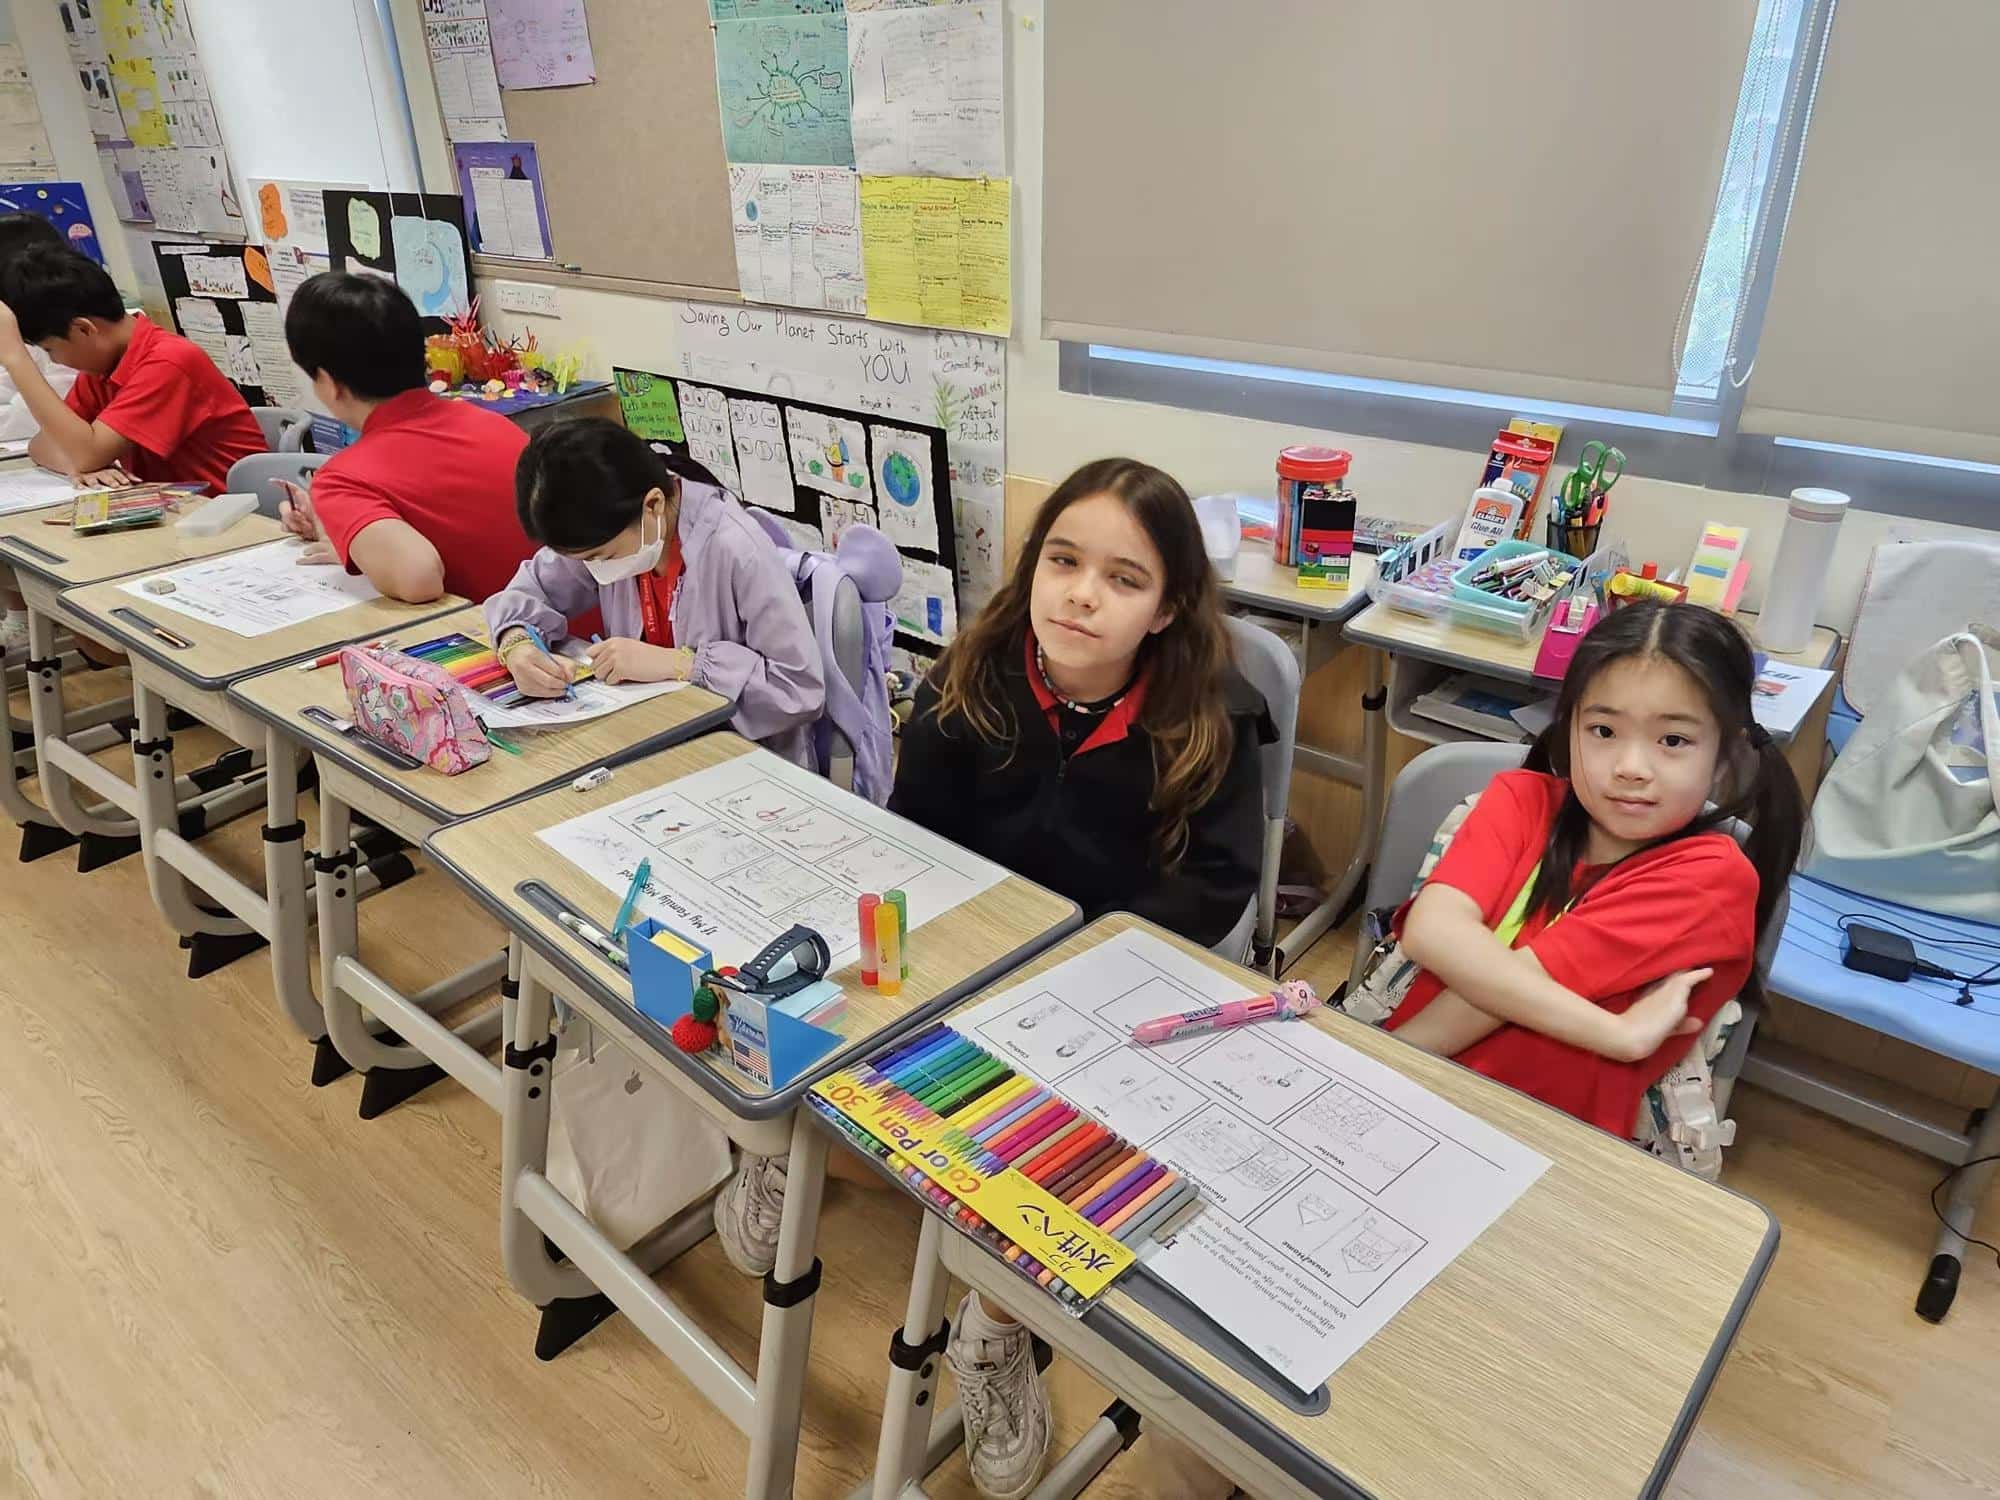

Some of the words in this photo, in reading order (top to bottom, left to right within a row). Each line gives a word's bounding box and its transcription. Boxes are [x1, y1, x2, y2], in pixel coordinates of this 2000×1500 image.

[680, 306, 730, 336] Saving
[737, 311, 762, 332] Our
[775, 310, 815, 341] Planet
[827, 324, 868, 348] Starts
[860, 354, 911, 384] YOU
[959, 422, 999, 443] Products
[658, 895, 690, 918] Family
[689, 915, 706, 932] My
[701, 924, 718, 935] If
[830, 1084, 868, 1111] 30
[1093, 1105, 1109, 1118] Food
[879, 1117, 923, 1150] Pen
[1314, 1146, 1344, 1167] Weather
[918, 1149, 981, 1193] Color
[1017, 1205, 1115, 1273] 水性ペン
[1039, 1248, 1076, 1272] カラー
[1282, 1242, 1331, 1281] House/Home
[1303, 1305, 1335, 1329] different
[1323, 1300, 1346, 1320] Which
[1295, 1313, 1327, 1338] Imagine
